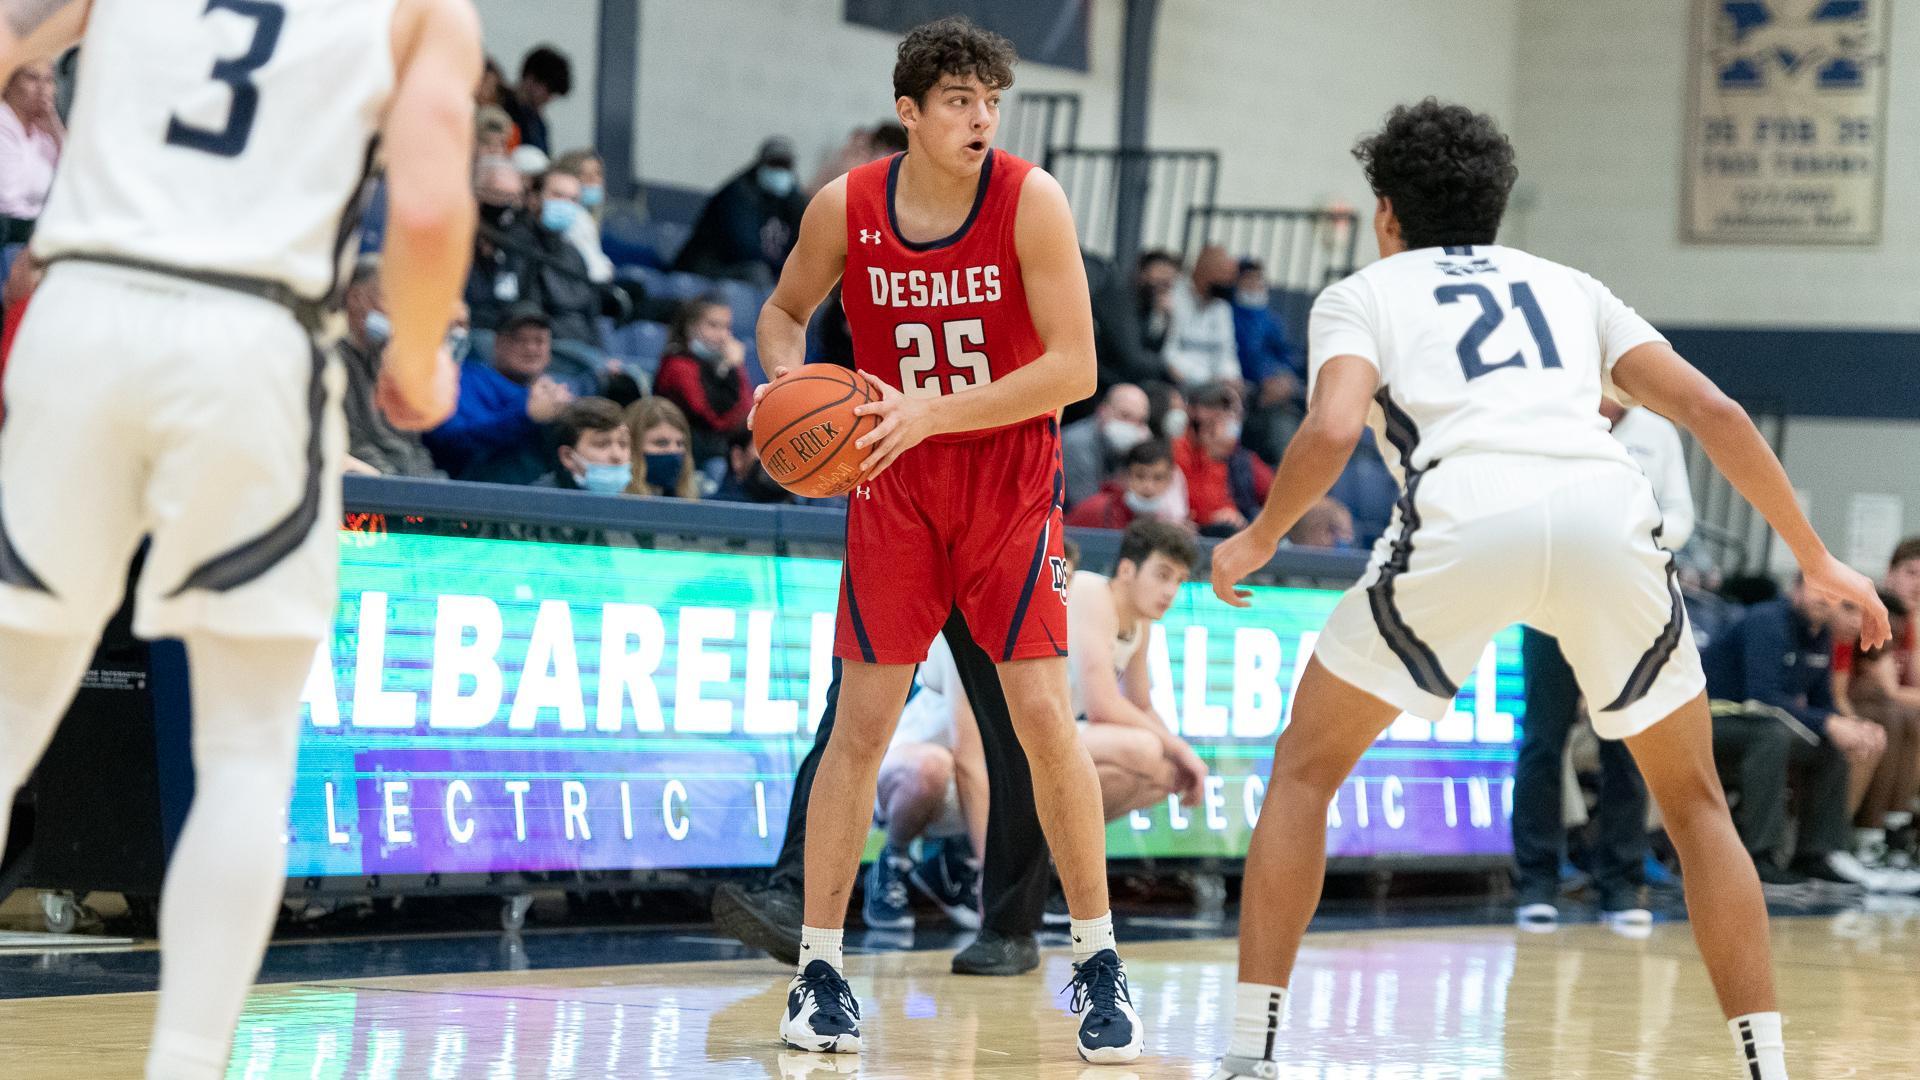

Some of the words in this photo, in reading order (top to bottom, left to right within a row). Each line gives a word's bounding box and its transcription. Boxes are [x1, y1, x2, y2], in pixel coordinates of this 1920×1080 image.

[164, 0, 286, 158] 3
[867, 265, 1001, 307] DESALES
[894, 317, 993, 399] 25
[1433, 280, 1564, 383] 21
[767, 447, 798, 478] THE
[789, 421, 839, 463] ROCK
[280, 779, 690, 844] LECTRIC
